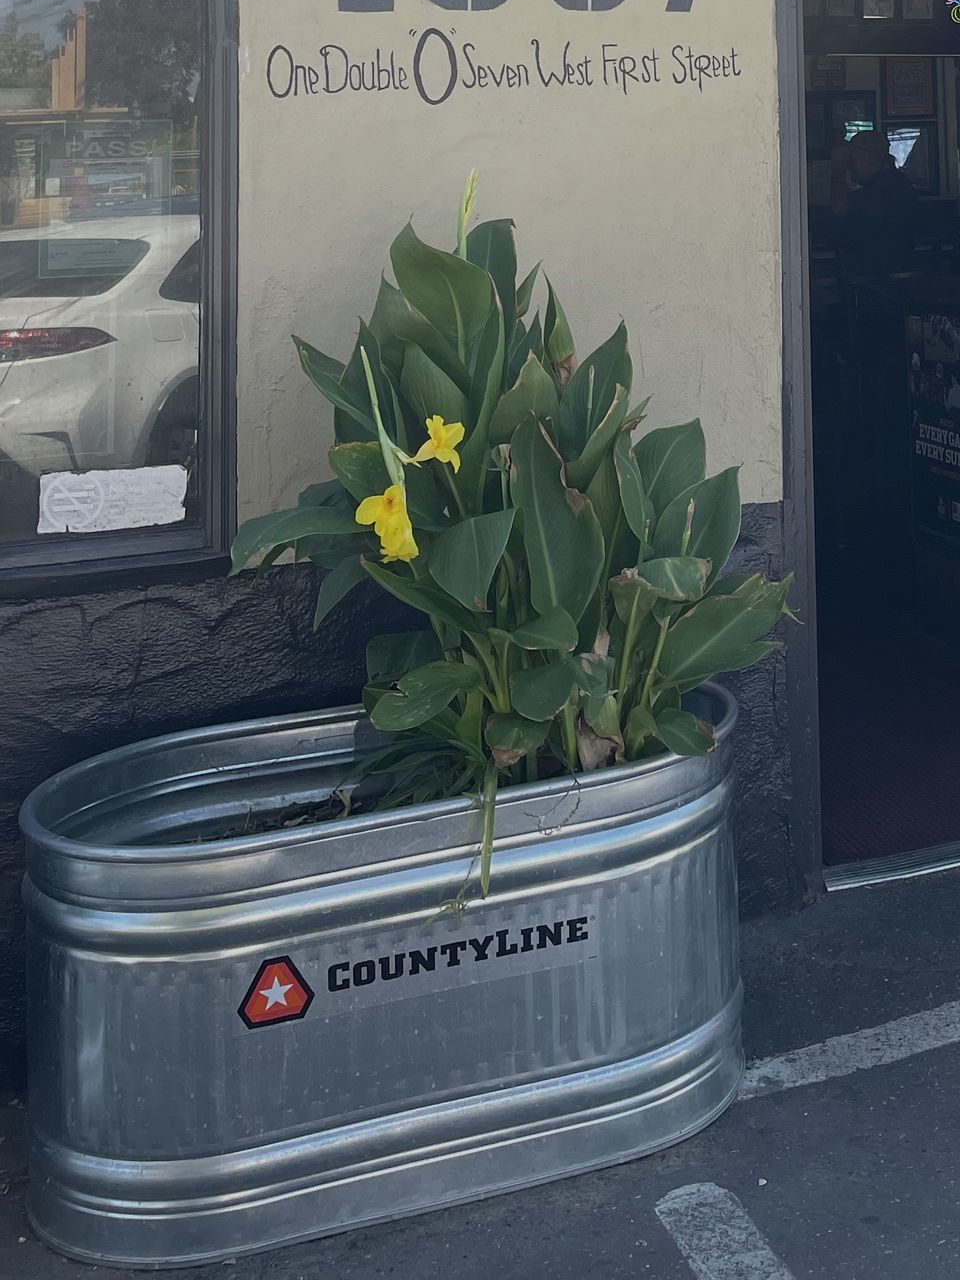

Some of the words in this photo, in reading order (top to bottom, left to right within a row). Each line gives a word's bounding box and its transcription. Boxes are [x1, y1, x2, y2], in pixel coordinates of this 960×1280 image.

[267, 45, 319, 98] One
[320, 45, 409, 93] Double
[462, 43, 530, 88] Seven
[531, 38, 593, 88] West
[66, 140, 147, 158] PASS
[919, 424, 949, 446] EVERY
[915, 440, 945, 462] EVERY
[327, 916, 589, 993] COUNTYLINE
